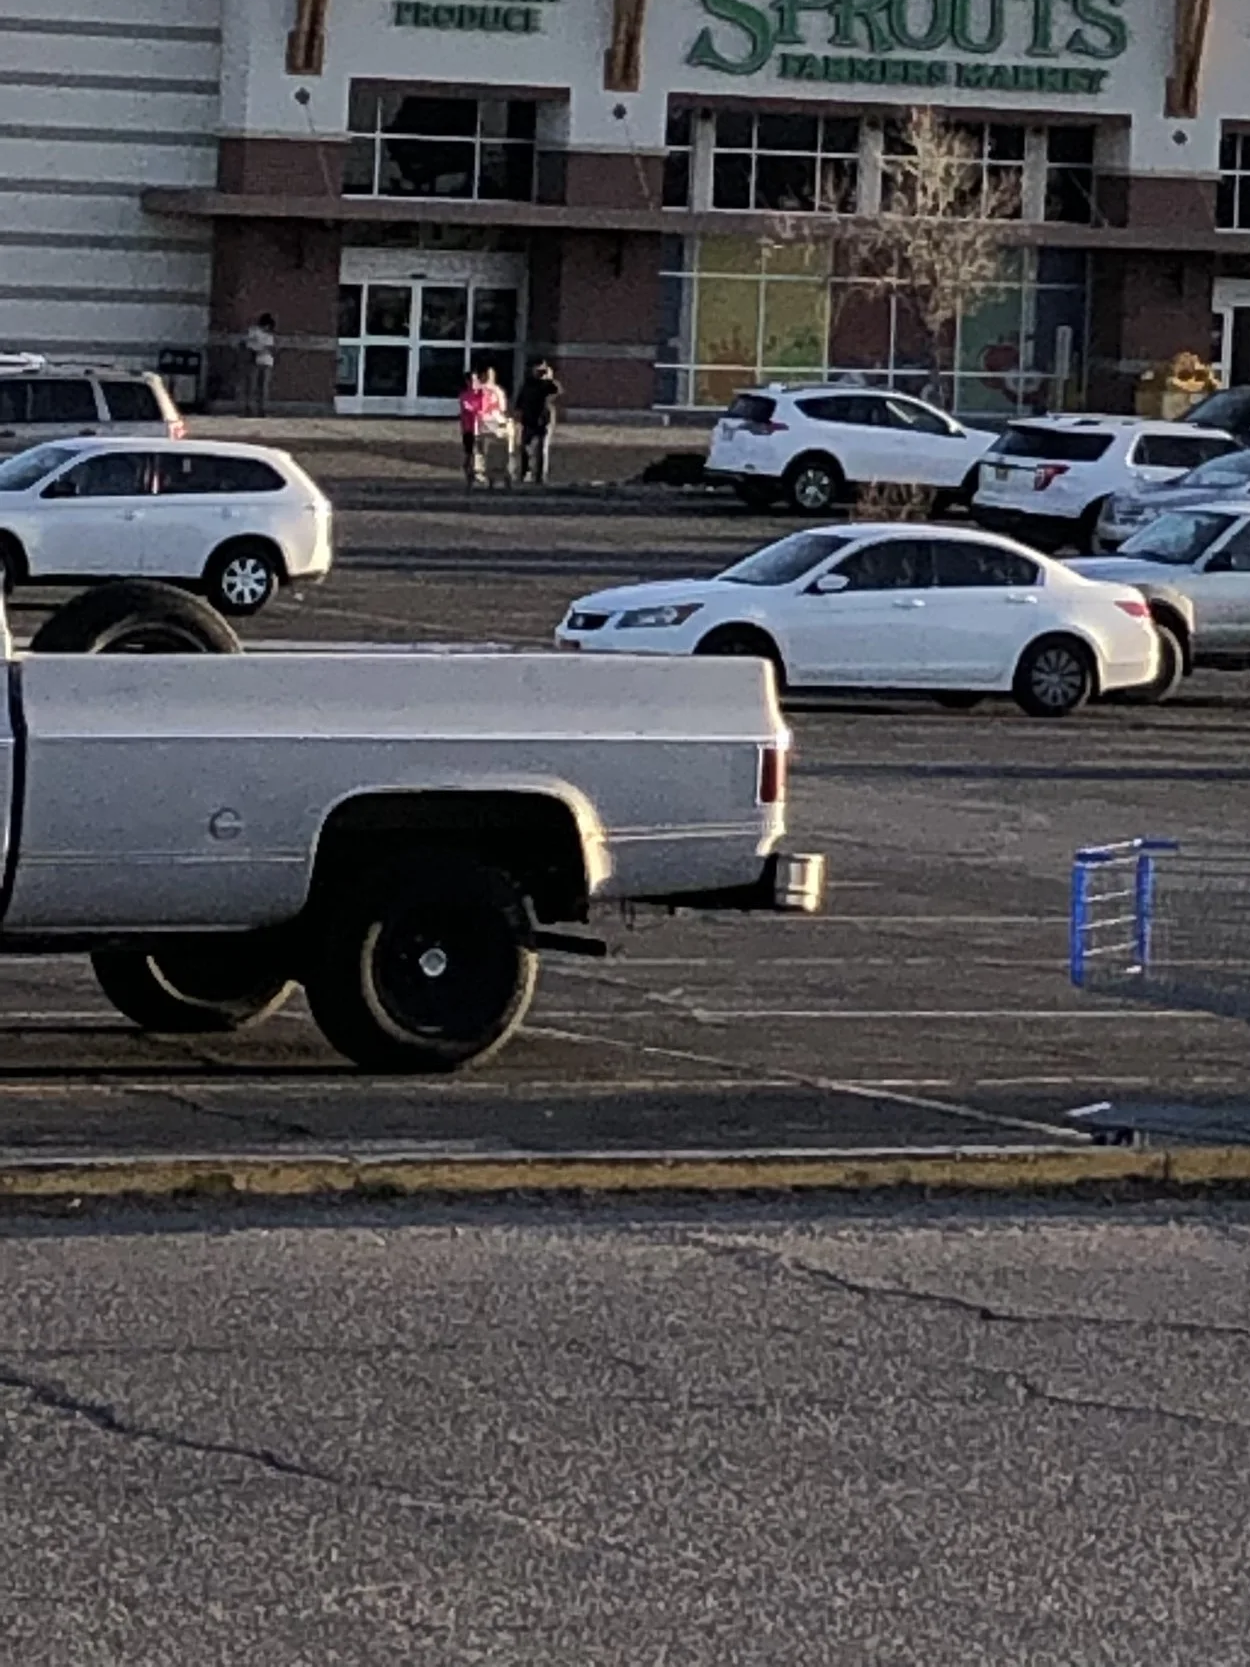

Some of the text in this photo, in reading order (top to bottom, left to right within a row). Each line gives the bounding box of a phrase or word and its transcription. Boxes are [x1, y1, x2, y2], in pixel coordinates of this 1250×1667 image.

[394, 1, 543, 34] PRODUCE
[776, 52, 1110, 94] FARMERS MARKET
